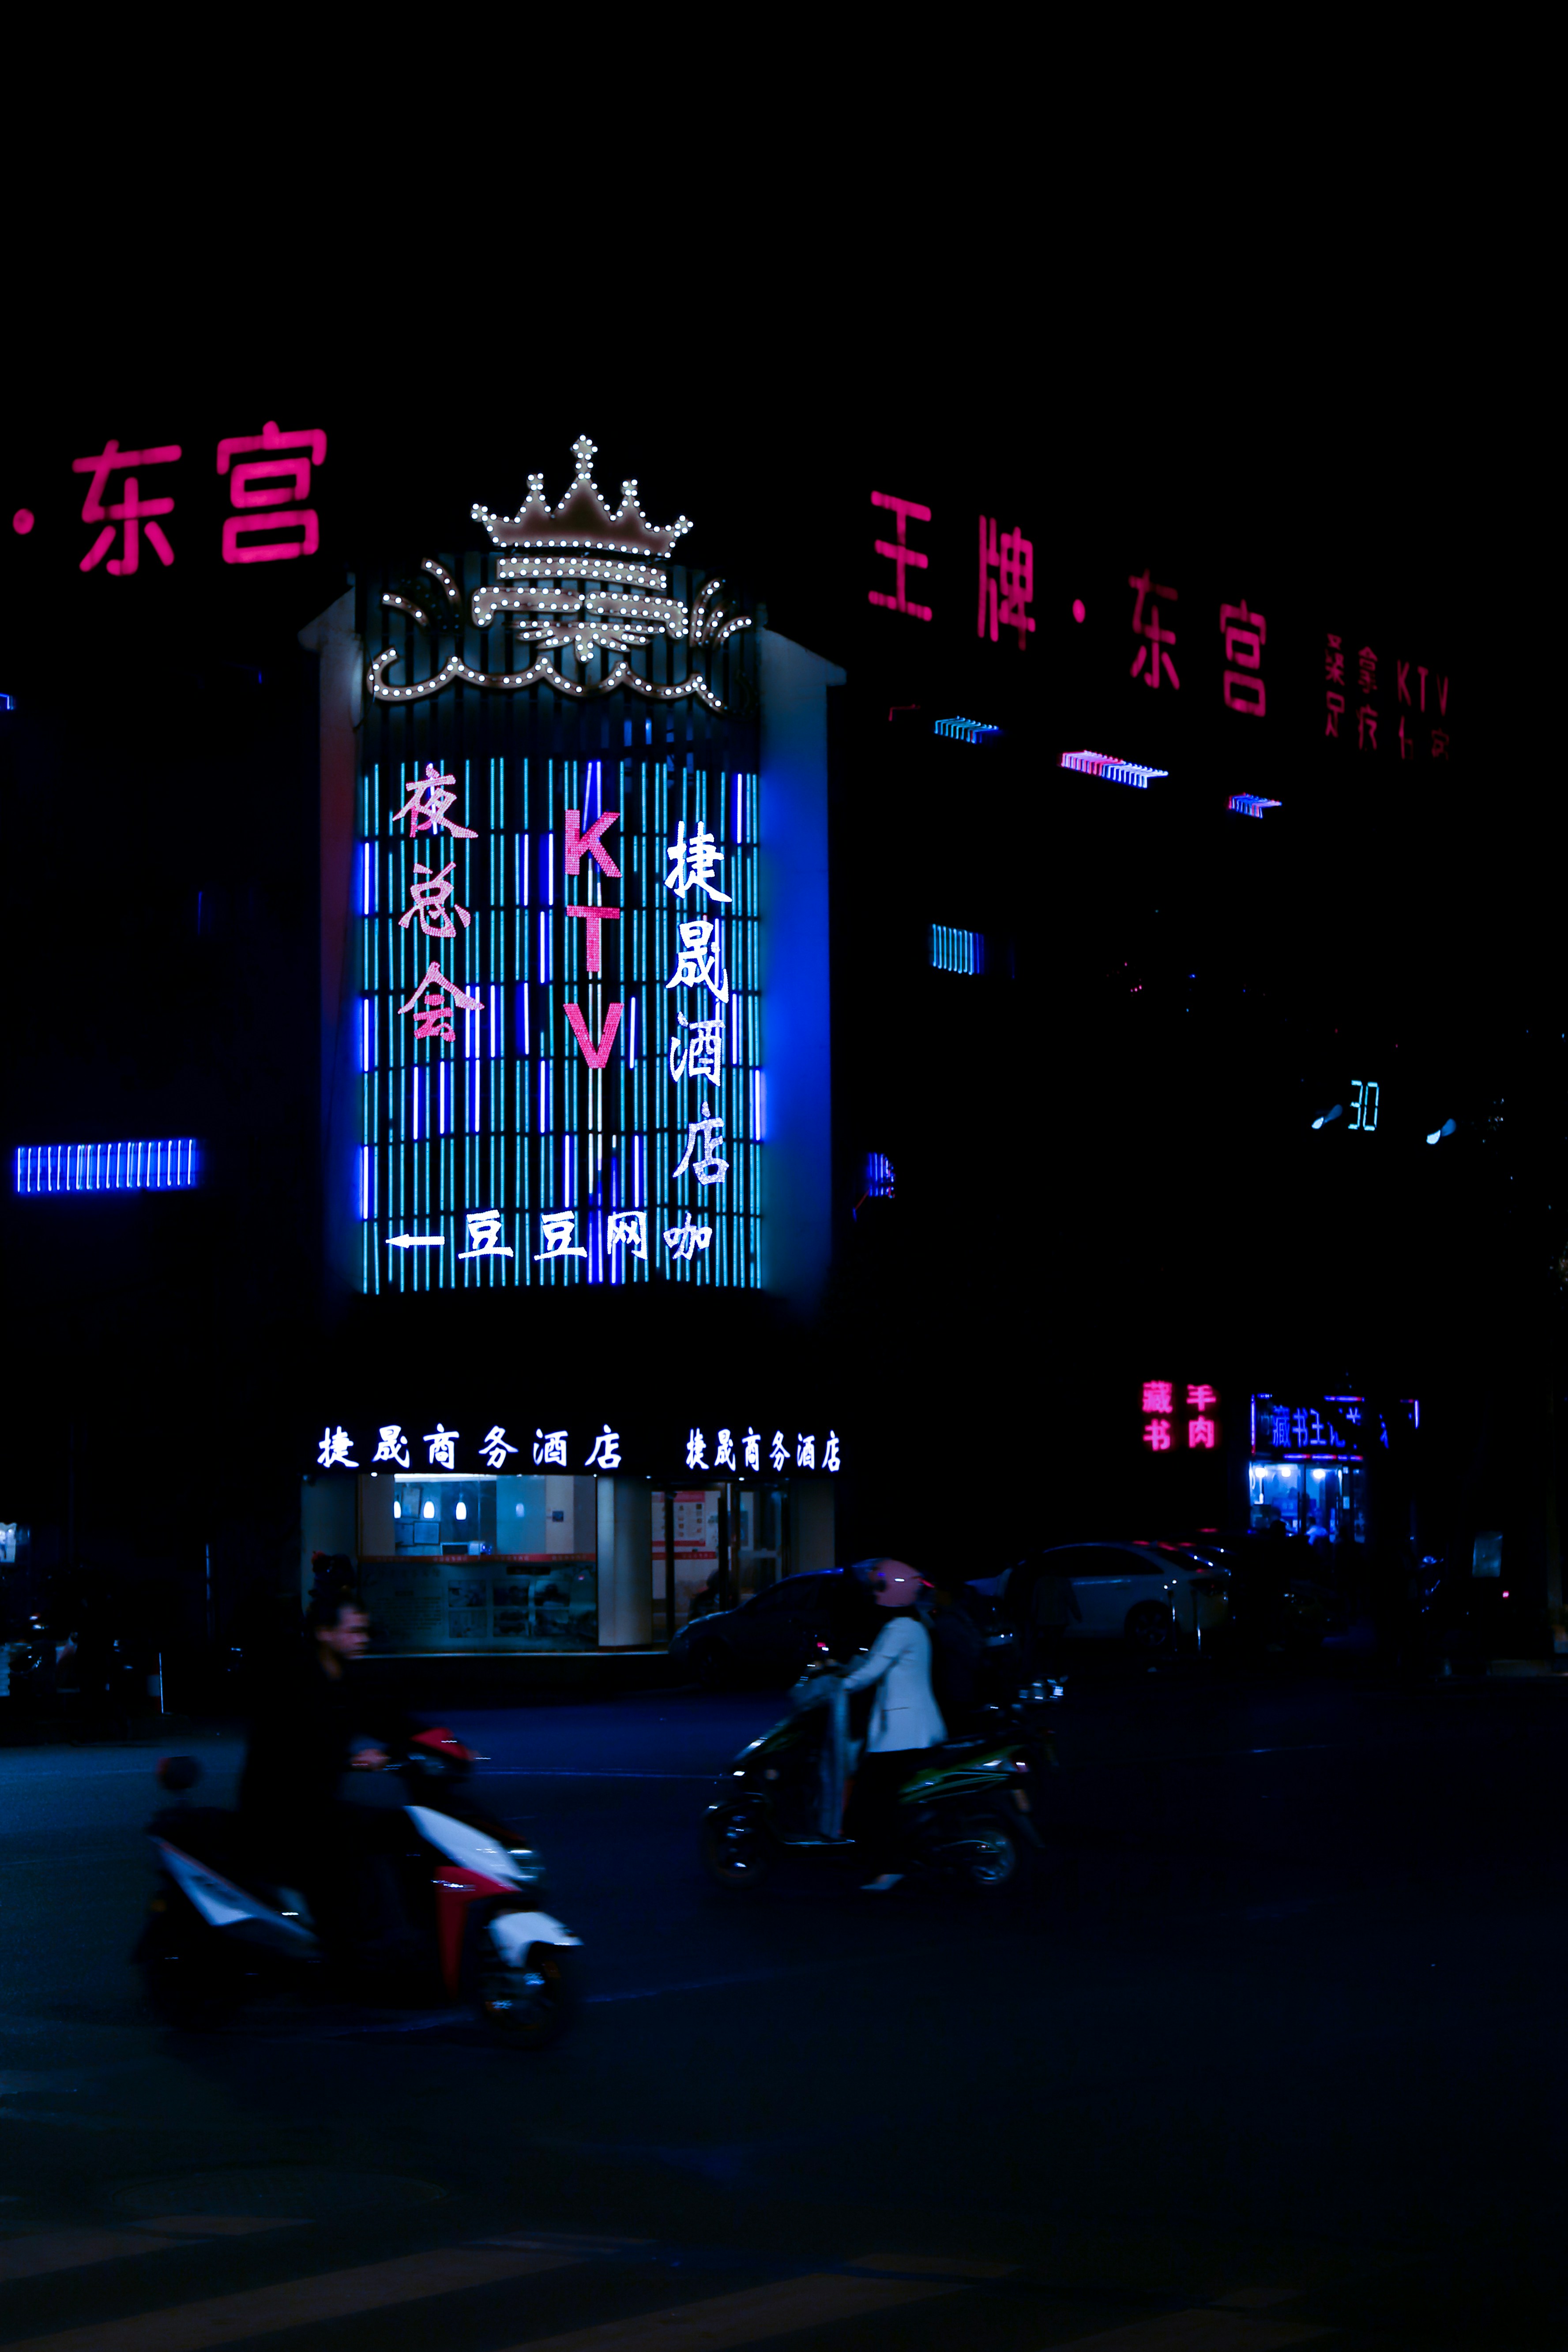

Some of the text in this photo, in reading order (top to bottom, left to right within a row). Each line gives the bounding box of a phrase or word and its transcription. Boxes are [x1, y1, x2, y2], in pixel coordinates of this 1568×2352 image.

[1396, 658, 1449, 718] KTV
[392, 763, 485, 1042] 夜总会
[564, 809, 624, 1069] KTV
[664, 820, 733, 1186] 捷晟酒店
[1347, 1079, 1380, 1131] 30
[458, 1209, 712, 1261] 豆豆网咖
[316, 1423, 622, 1470] 捷晟商务酒店
[685, 1426, 842, 1472] 捷晟商务酒店
